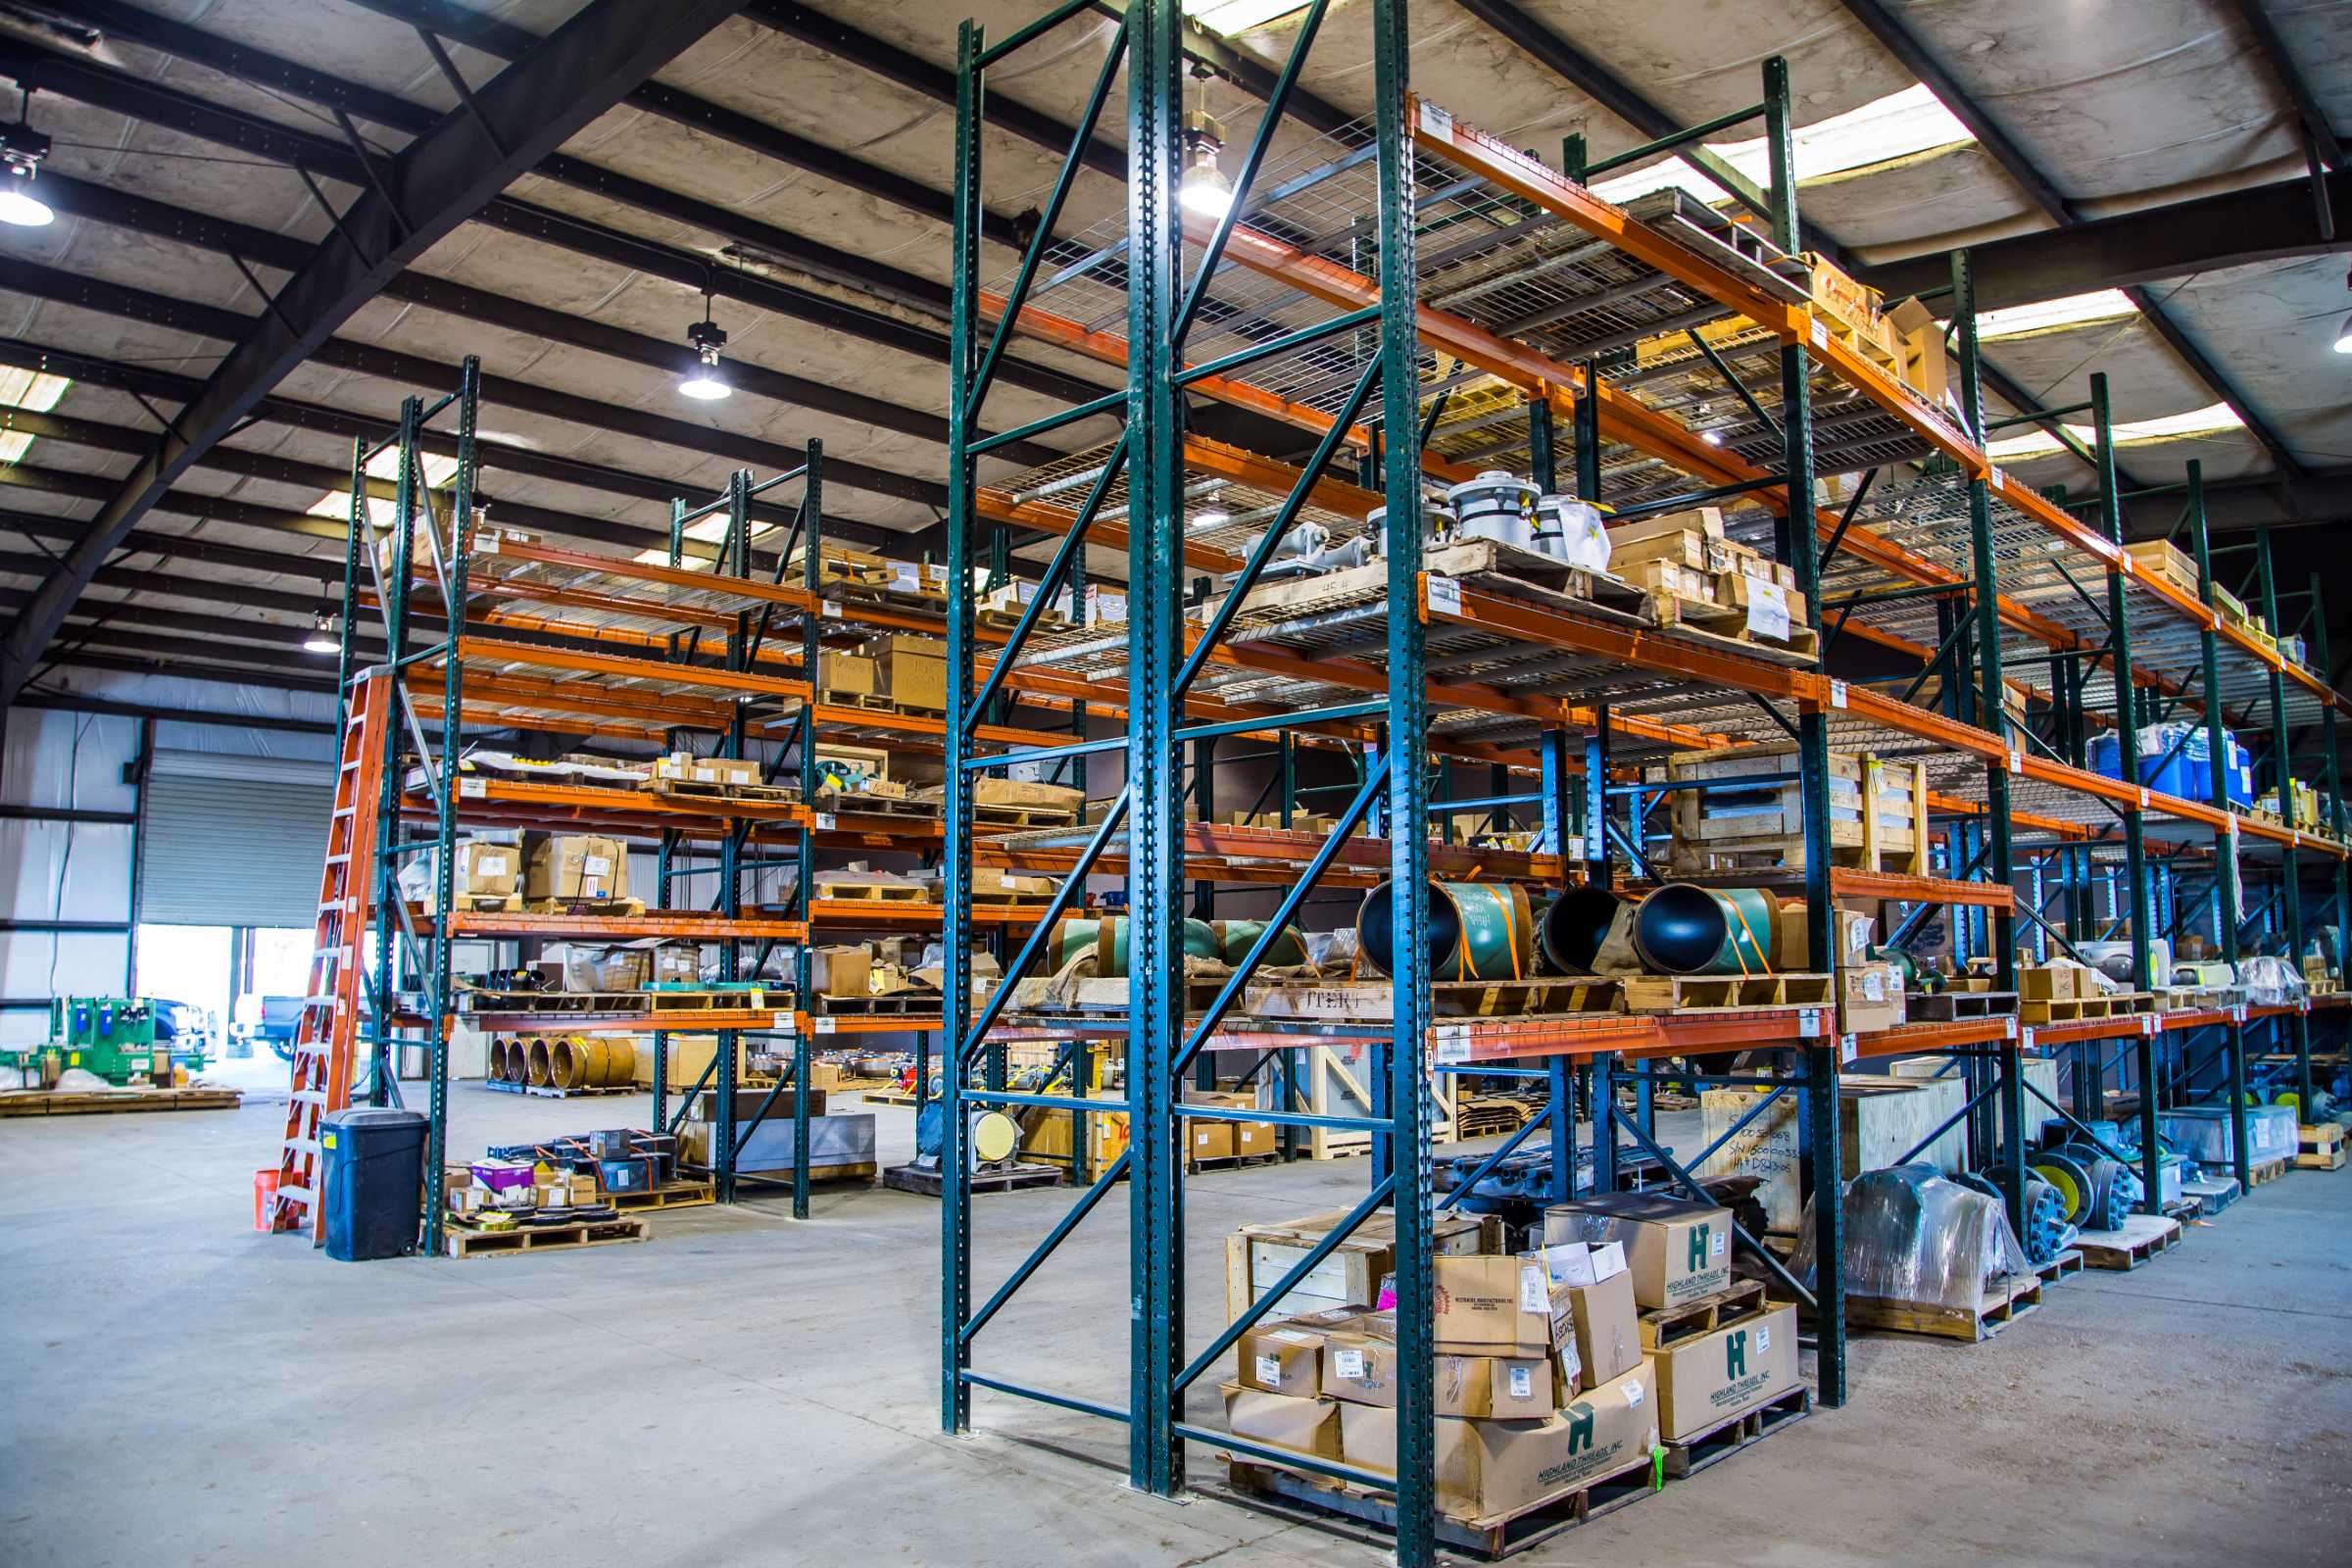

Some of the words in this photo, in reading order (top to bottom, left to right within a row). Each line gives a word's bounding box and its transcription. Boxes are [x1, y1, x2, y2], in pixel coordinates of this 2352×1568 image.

[1689, 1223, 1709, 1272] H
[1727, 1329, 1747, 1381] H
[1710, 1384, 1737, 1401] HIGHLAND
[1538, 1458, 1577, 1483] HIGHLAND
